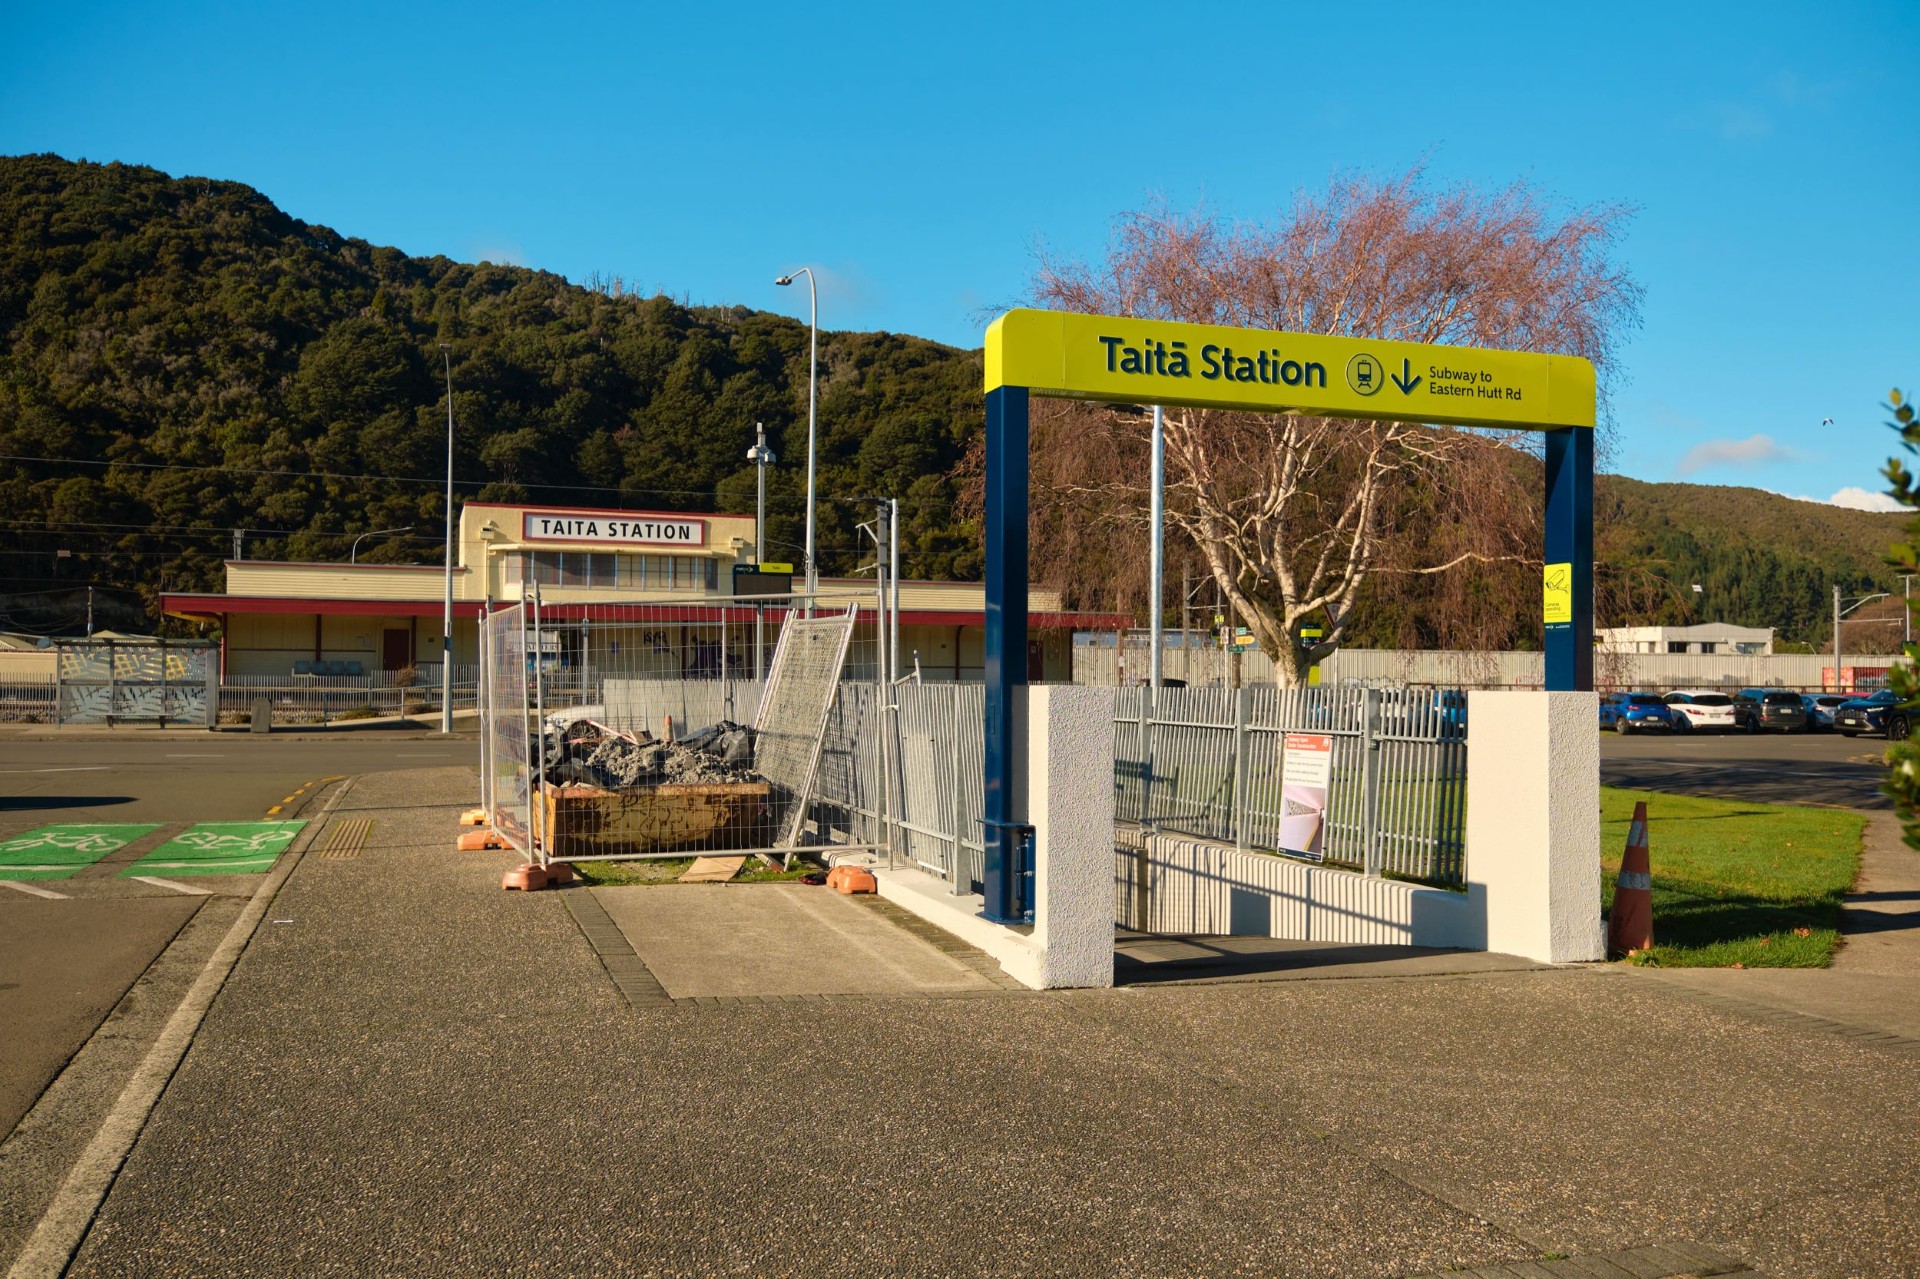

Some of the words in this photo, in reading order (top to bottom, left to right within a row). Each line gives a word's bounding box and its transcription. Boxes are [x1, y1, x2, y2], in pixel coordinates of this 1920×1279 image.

[1098, 336, 1191, 378] Taitā
[1200, 344, 1326, 387] Station
[1430, 366, 1477, 384] Subway
[1480, 370, 1492, 382] to
[1430, 382, 1474, 397] Eastern
[1477, 385, 1502, 399] Hutt
[1505, 388, 1521, 400] Rd
[541, 520, 598, 536] TAITA
[608, 522, 690, 540] STATION
